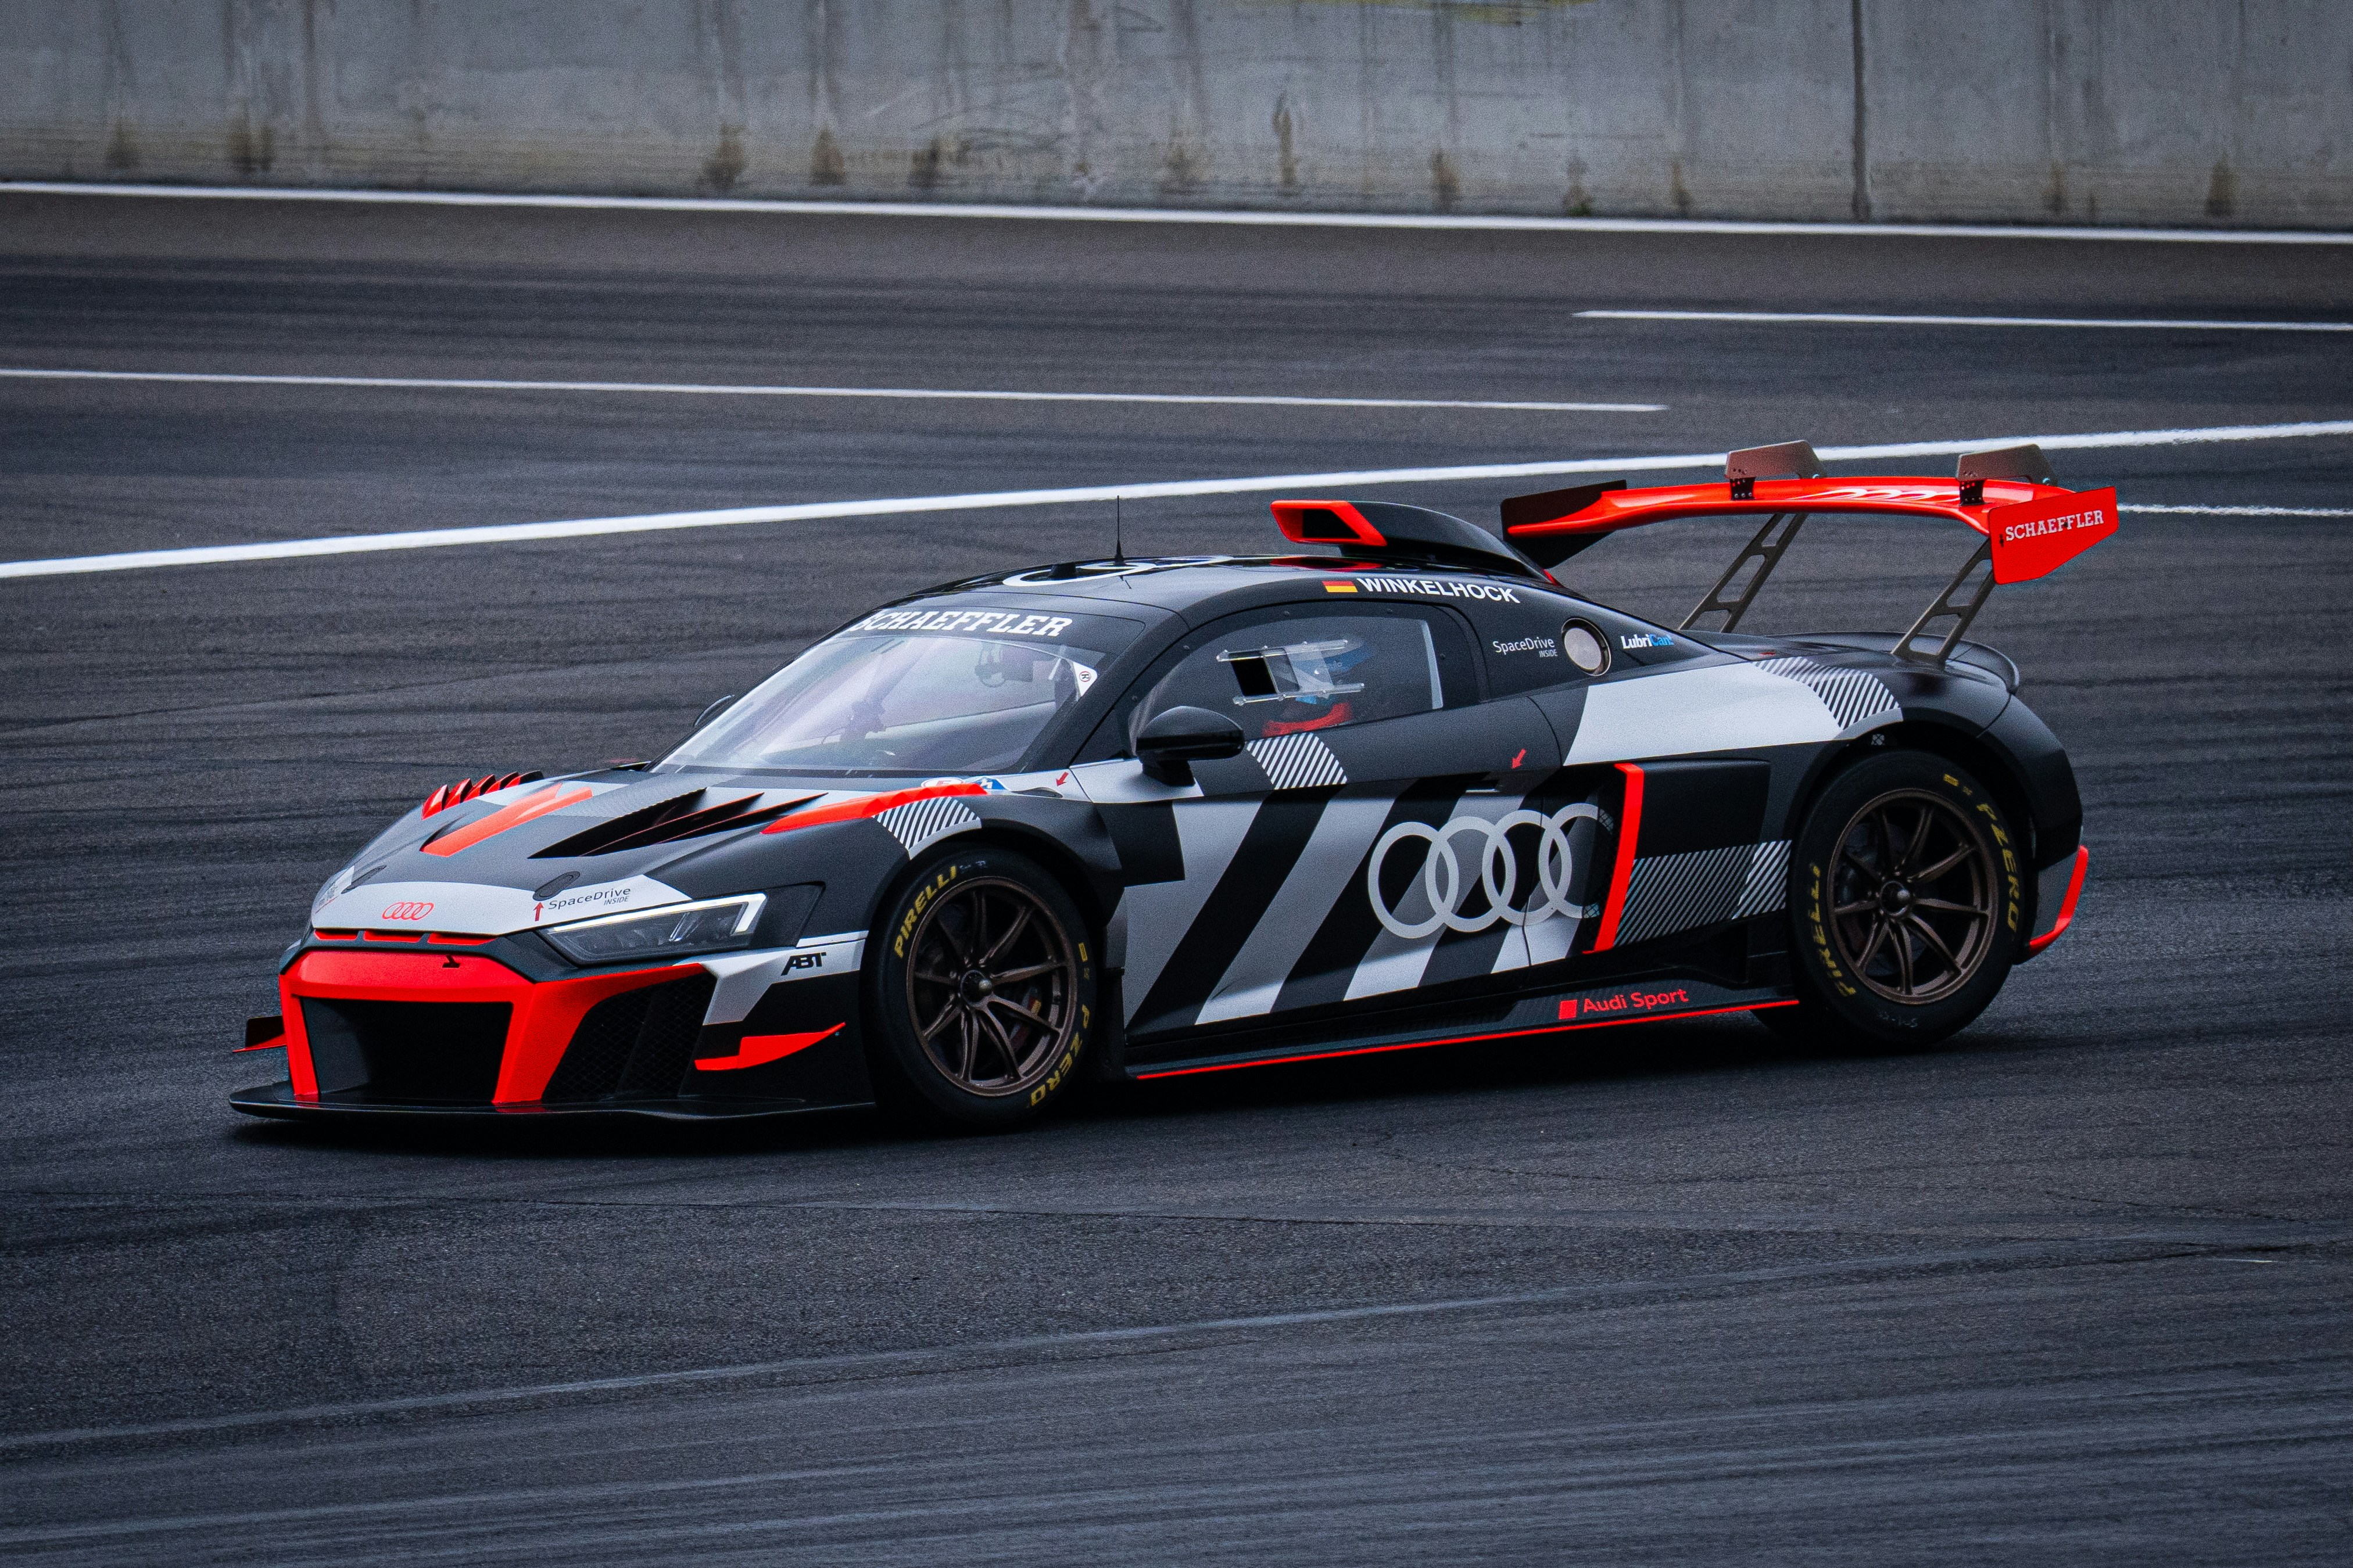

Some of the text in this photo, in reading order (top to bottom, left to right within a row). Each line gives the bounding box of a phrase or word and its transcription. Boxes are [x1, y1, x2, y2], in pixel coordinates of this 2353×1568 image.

[2005, 509, 2104, 541] SCHAEFFLER
[1356, 577, 1521, 604] WINKELHOCK
[848, 610, 1073, 637] SCHAEFFLER
[1492, 636, 1555, 655] SpaceDrive
[1539, 649, 1558, 658] INSIDE
[1991, 824, 2020, 932] ZERO
[548, 888, 631, 910] SpaceDrive
[603, 895, 630, 906] INSIDE
[894, 864, 957, 959] PIRELLI
[780, 952, 827, 977] ABT
[1584, 988, 1689, 1013] Audi Sport
[1030, 1032, 1083, 1107] ZERO
